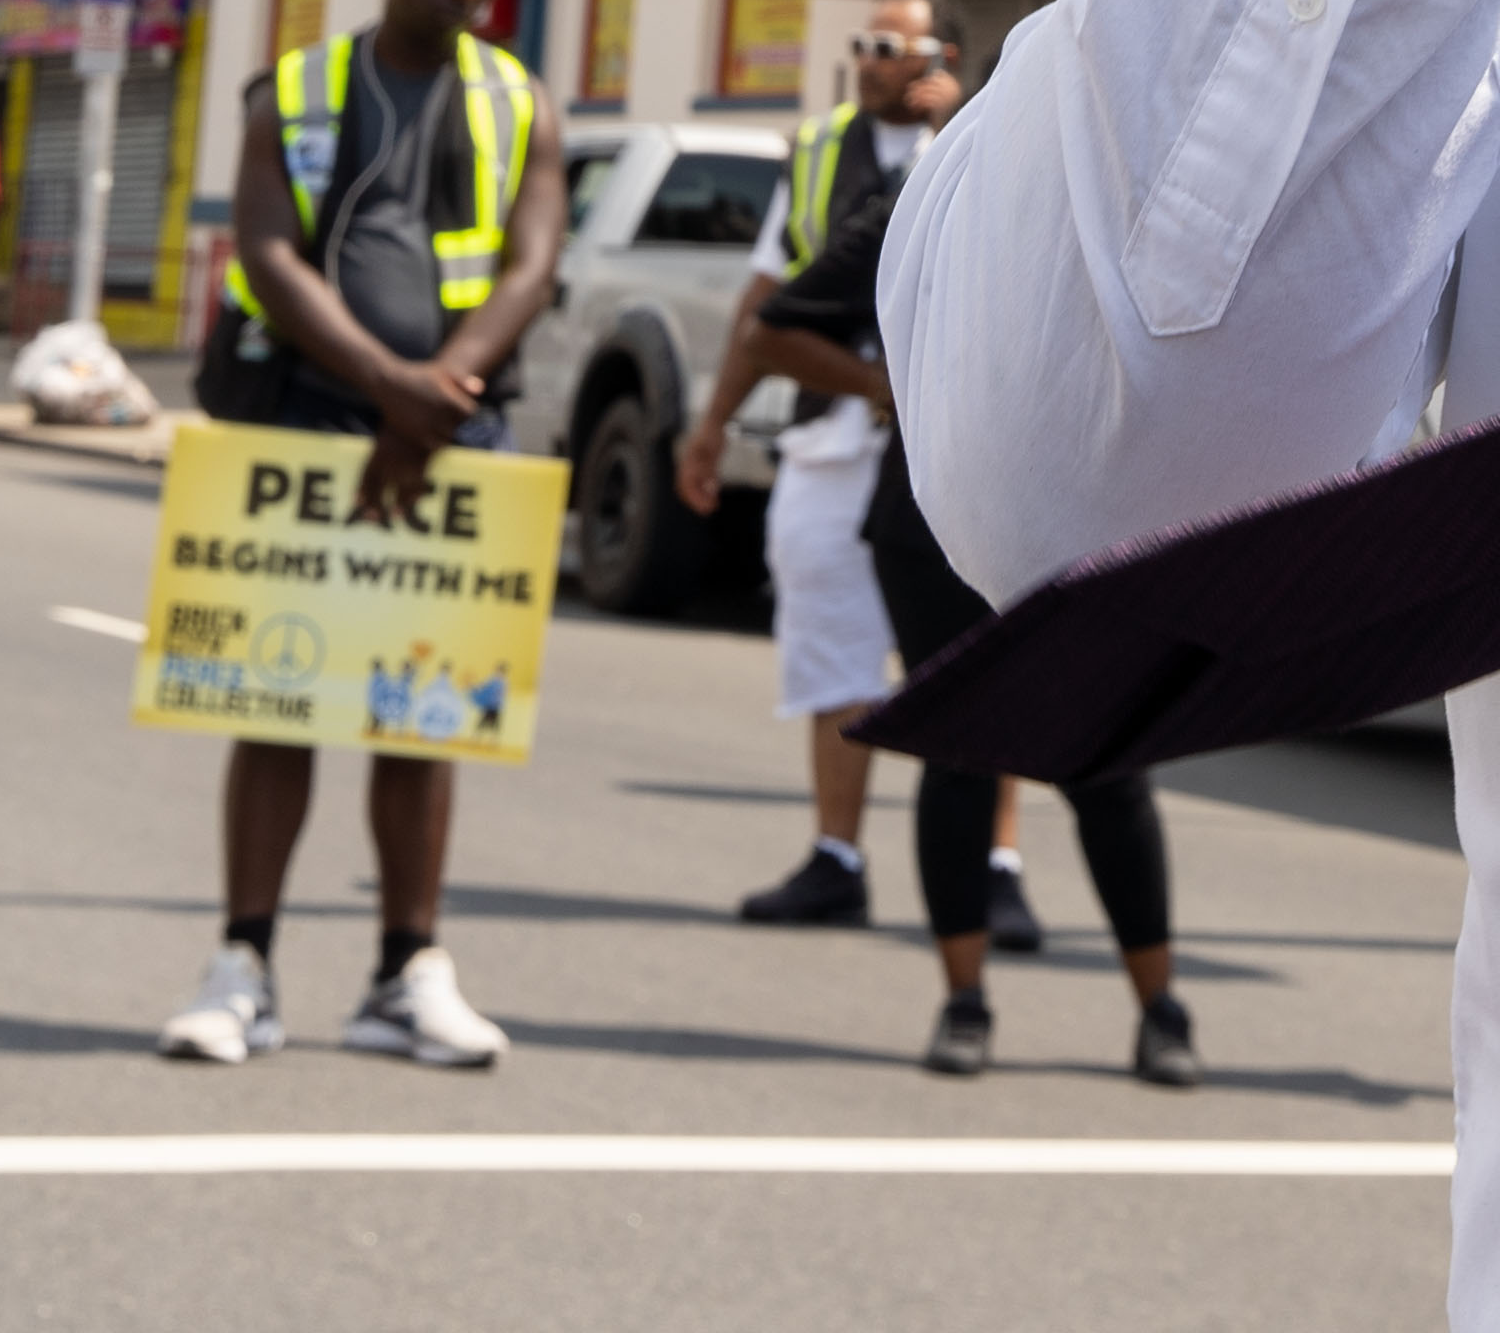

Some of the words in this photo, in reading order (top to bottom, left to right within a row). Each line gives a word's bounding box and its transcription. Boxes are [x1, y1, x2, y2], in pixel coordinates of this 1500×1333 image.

[172, 536, 329, 583] BEGINS
[344, 551, 463, 596] WITH
[473, 565, 533, 604] ME
